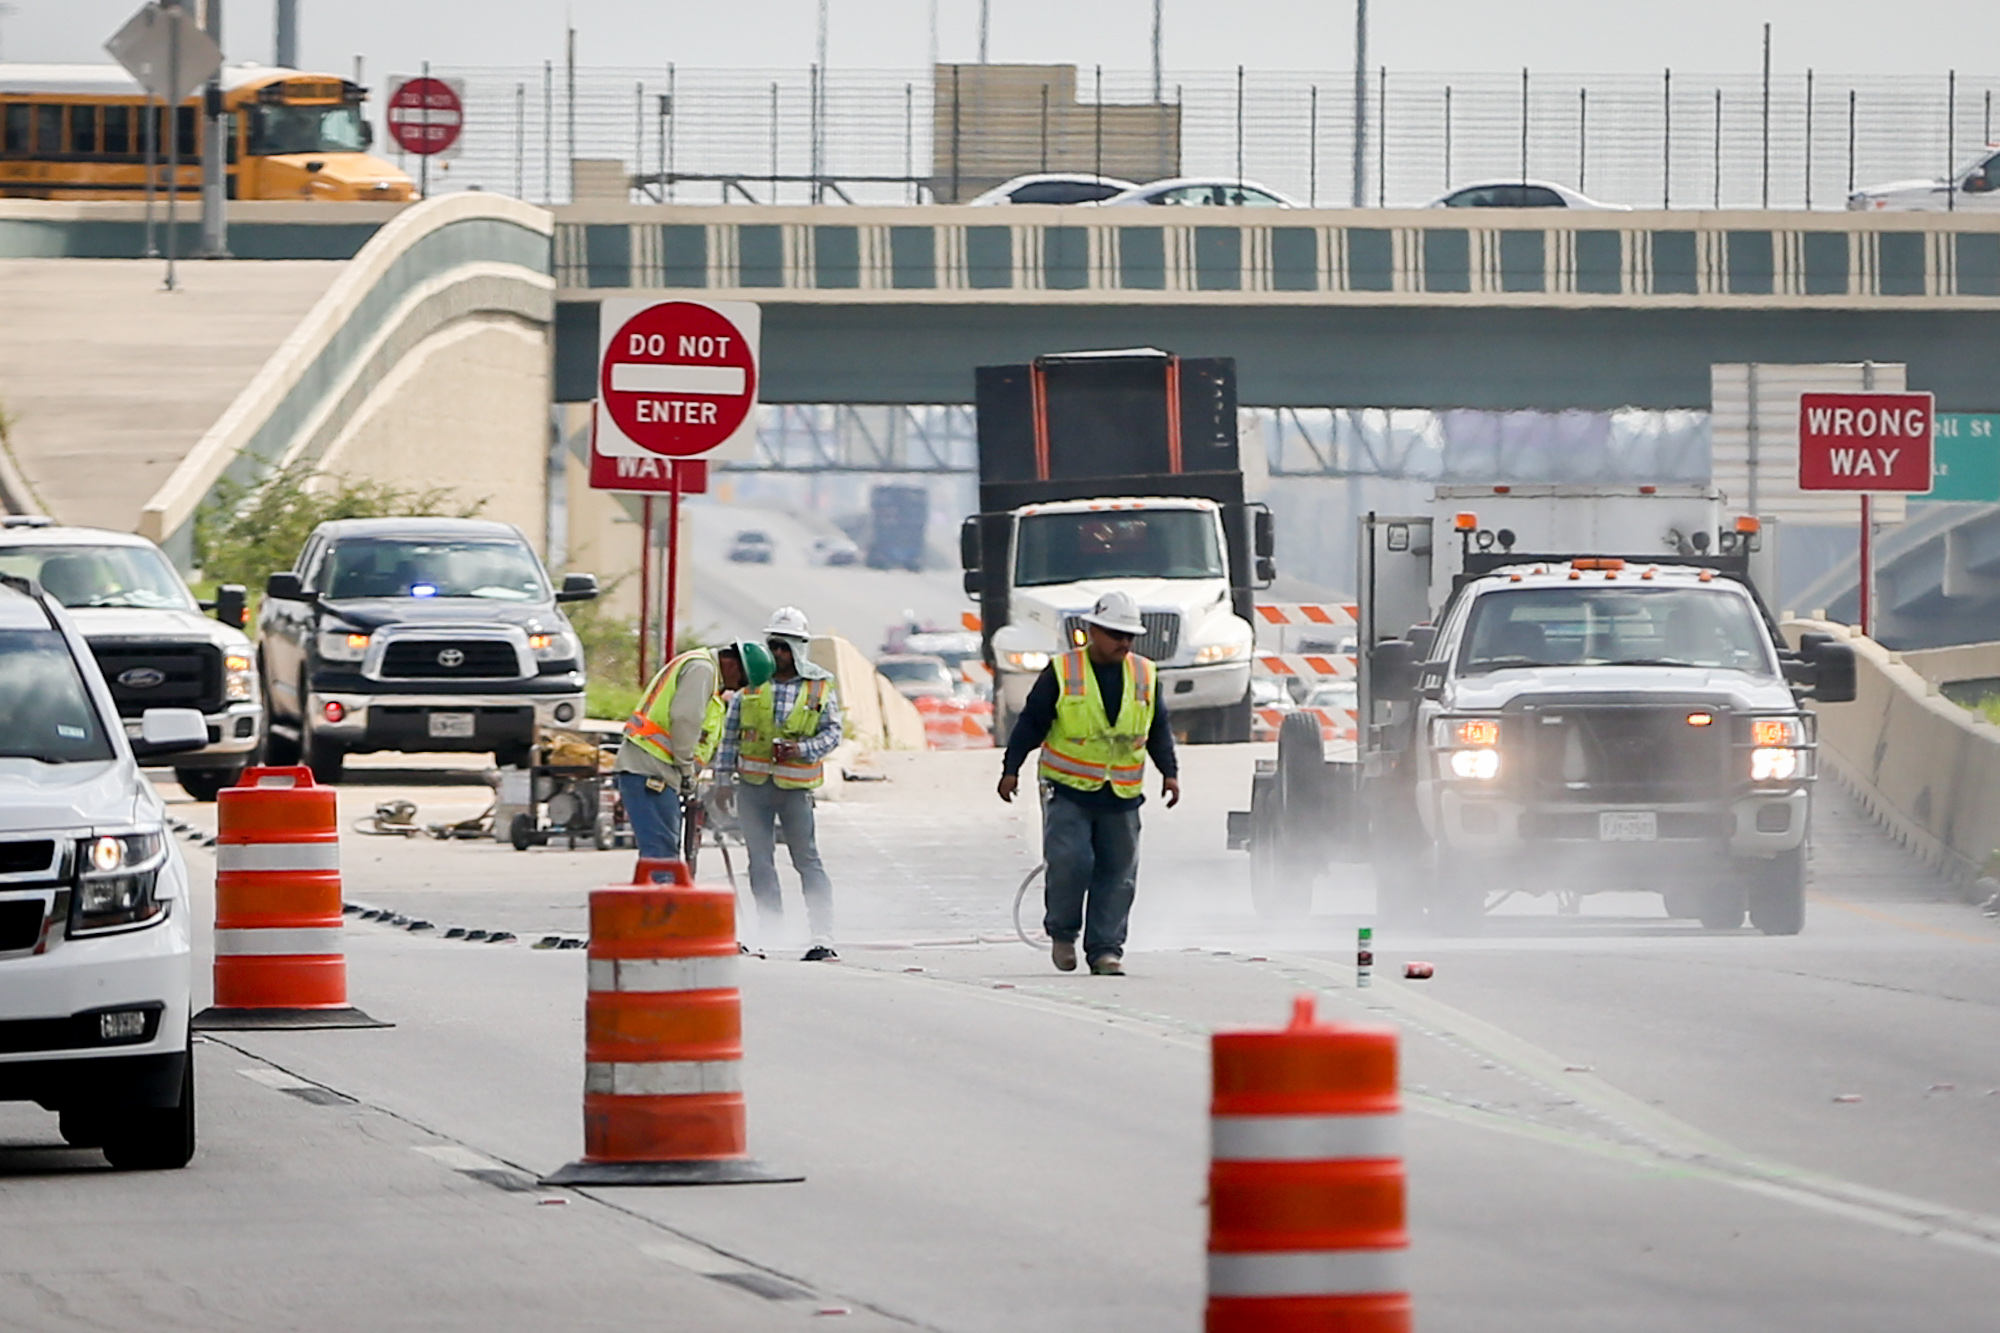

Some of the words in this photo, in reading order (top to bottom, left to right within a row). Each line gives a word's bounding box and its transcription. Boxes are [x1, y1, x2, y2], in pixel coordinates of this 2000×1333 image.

[629, 334, 665, 356] DO
[678, 335, 731, 358] NOT
[636, 400, 718, 424] ENTER
[1808, 407, 1924, 437] WRONG
[1970, 419, 1992, 438] St
[1829, 448, 1900, 477] WAY
